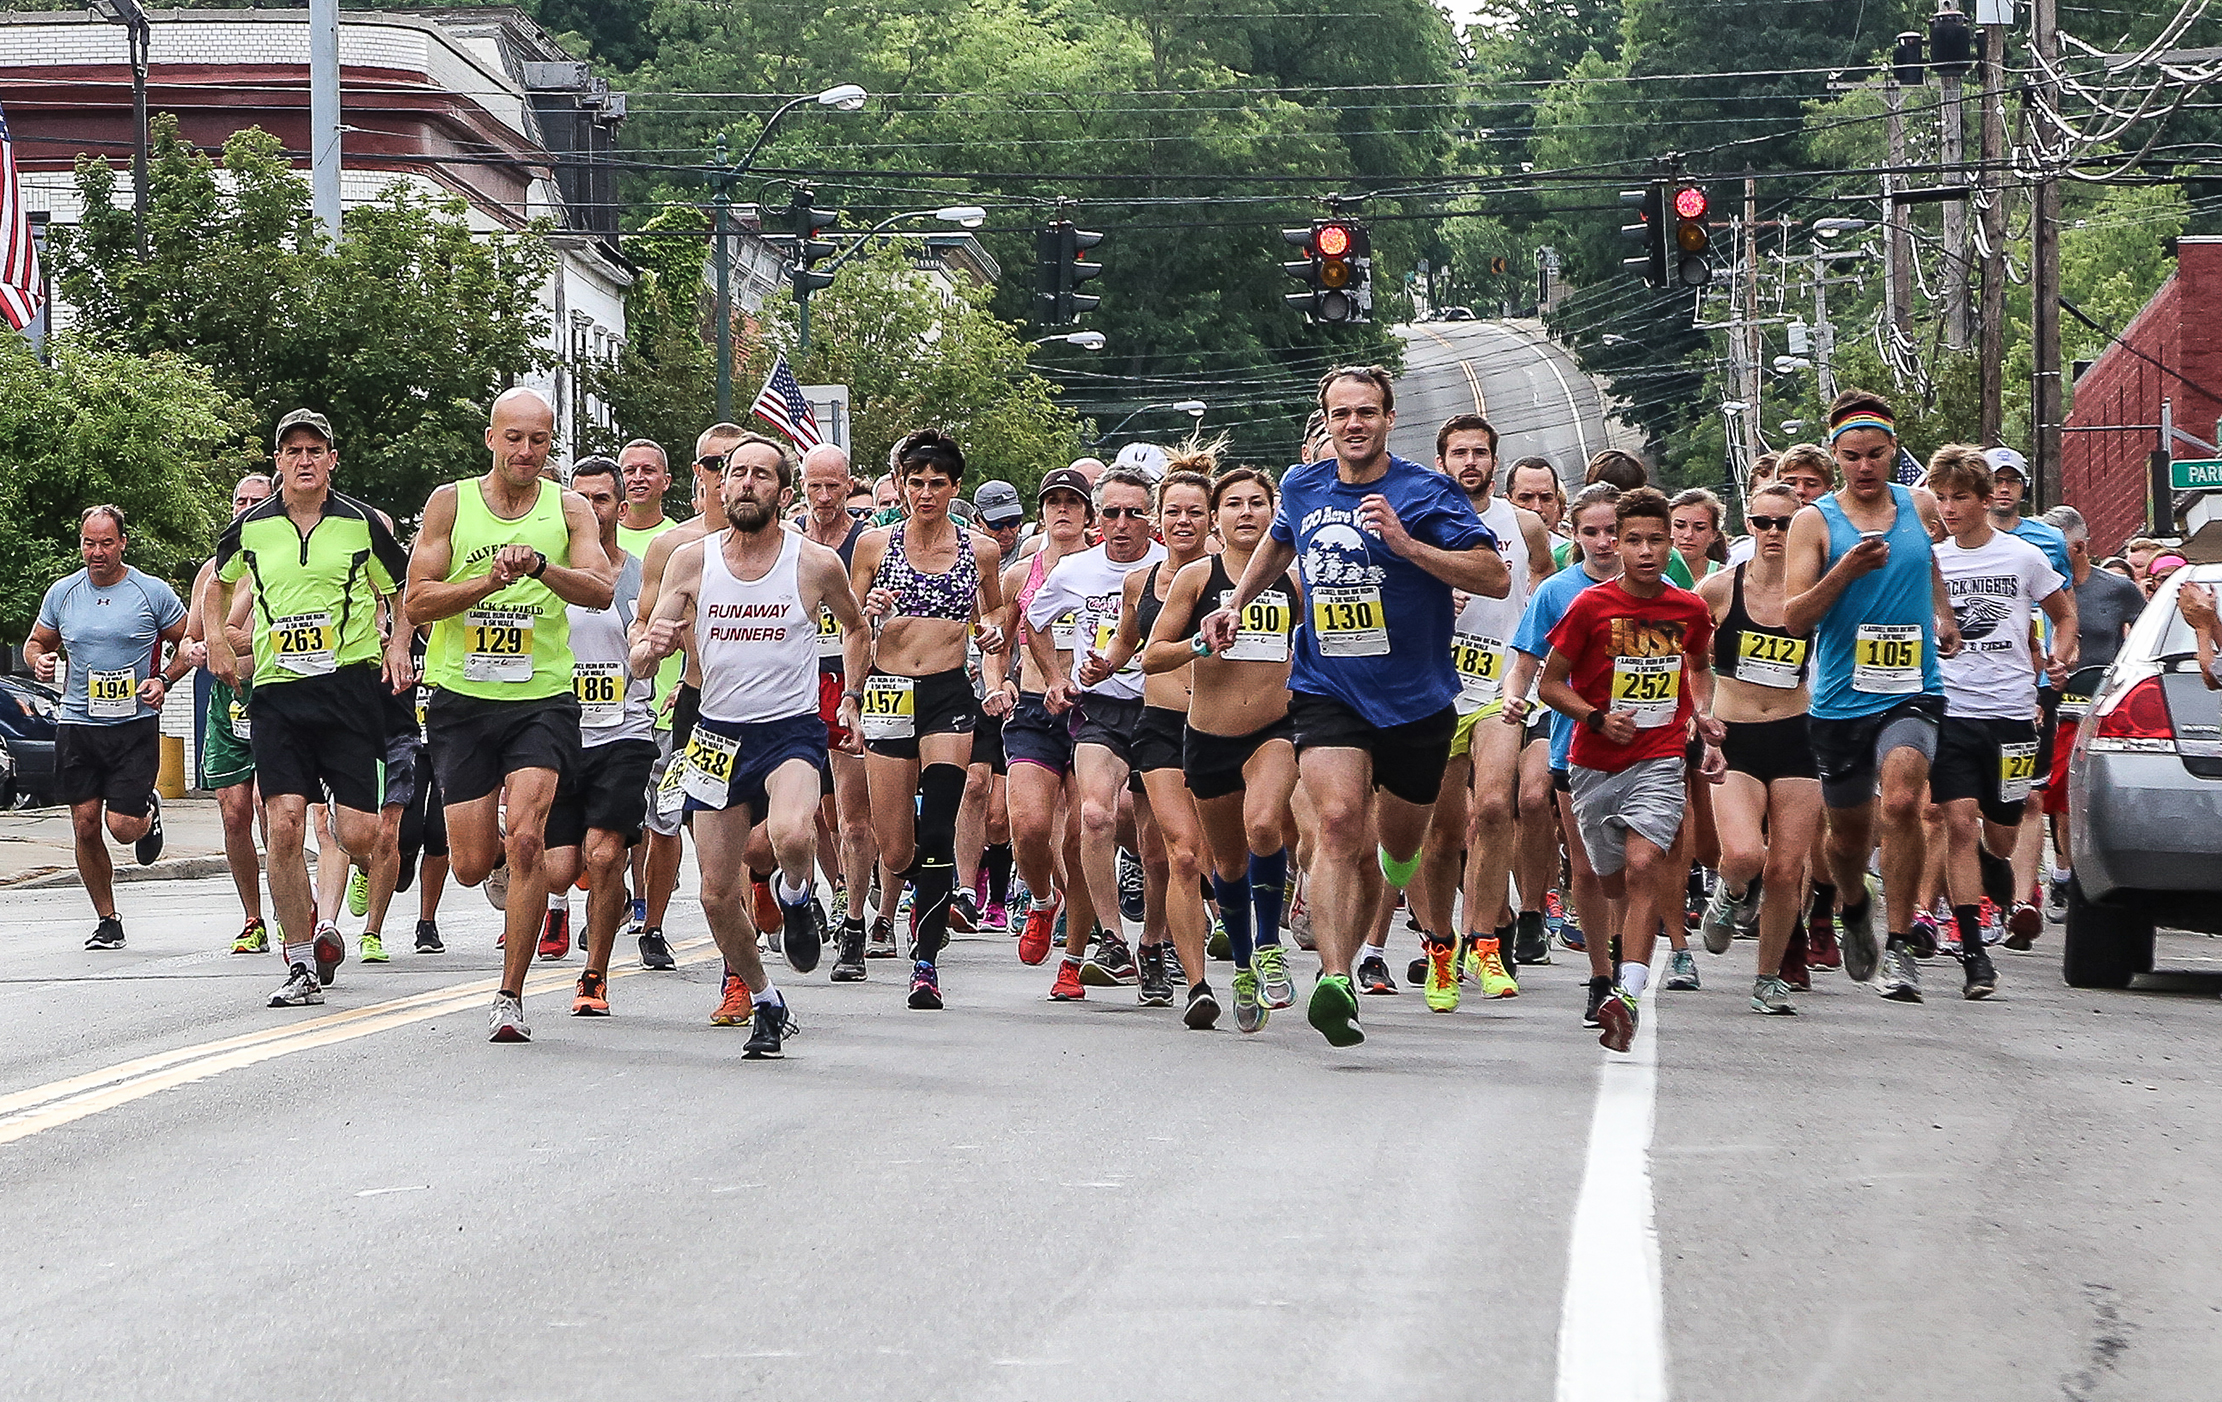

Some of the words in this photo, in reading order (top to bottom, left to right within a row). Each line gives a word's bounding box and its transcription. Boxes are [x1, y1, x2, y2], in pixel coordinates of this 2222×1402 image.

[1321, 505, 1352, 524] Acre
[1972, 577, 2018, 597] NIGHTS
[472, 601, 496, 612] ACK
[512, 604, 544, 616] FIELD
[708, 604, 791, 619] RUNAWAY
[1239, 604, 1279, 632] 90
[1324, 602, 1374, 630] 130
[279, 626, 323, 653] 263
[476, 626, 522, 654] 129
[710, 627, 786, 641] RUNNERS
[1981, 640, 2013, 651] FIELD
[1451, 645, 1494, 676] 183
[1749, 634, 1796, 664] 212
[1867, 640, 1914, 667] 105
[96, 679, 130, 700] 194
[573, 676, 614, 702] 186
[1622, 672, 1672, 700] 252
[866, 690, 904, 714] 157
[690, 741, 729, 777] 258
